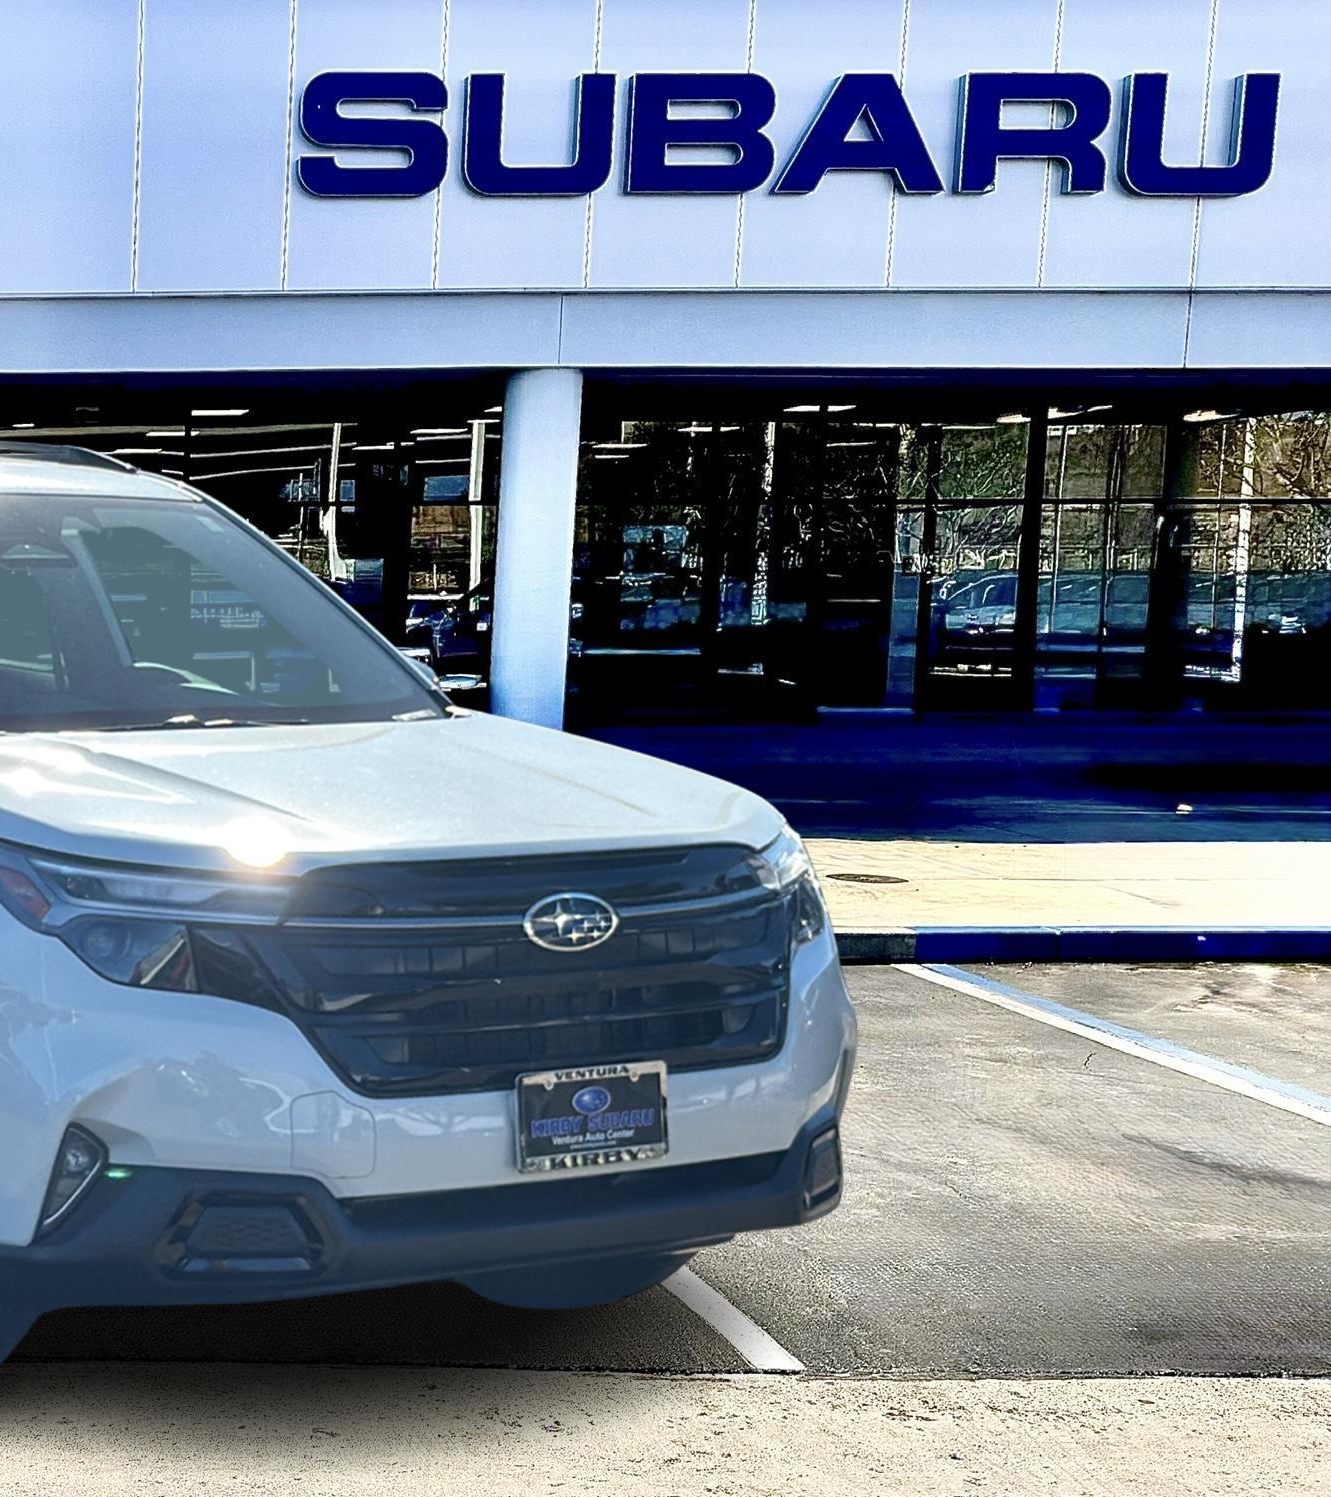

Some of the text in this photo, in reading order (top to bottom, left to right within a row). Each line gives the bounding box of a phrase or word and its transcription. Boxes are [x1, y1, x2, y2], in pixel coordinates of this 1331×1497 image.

[297, 71, 1281, 198] SUBARU
[554, 1066, 630, 1082] VENTURA
[530, 1108, 655, 1138] KIRBY SUBARU
[551, 1134, 584, 1146] Ventura
[585, 1131, 606, 1143] Auto
[606, 1128, 636, 1140] Center
[550, 1148, 642, 1170] KIRBY
